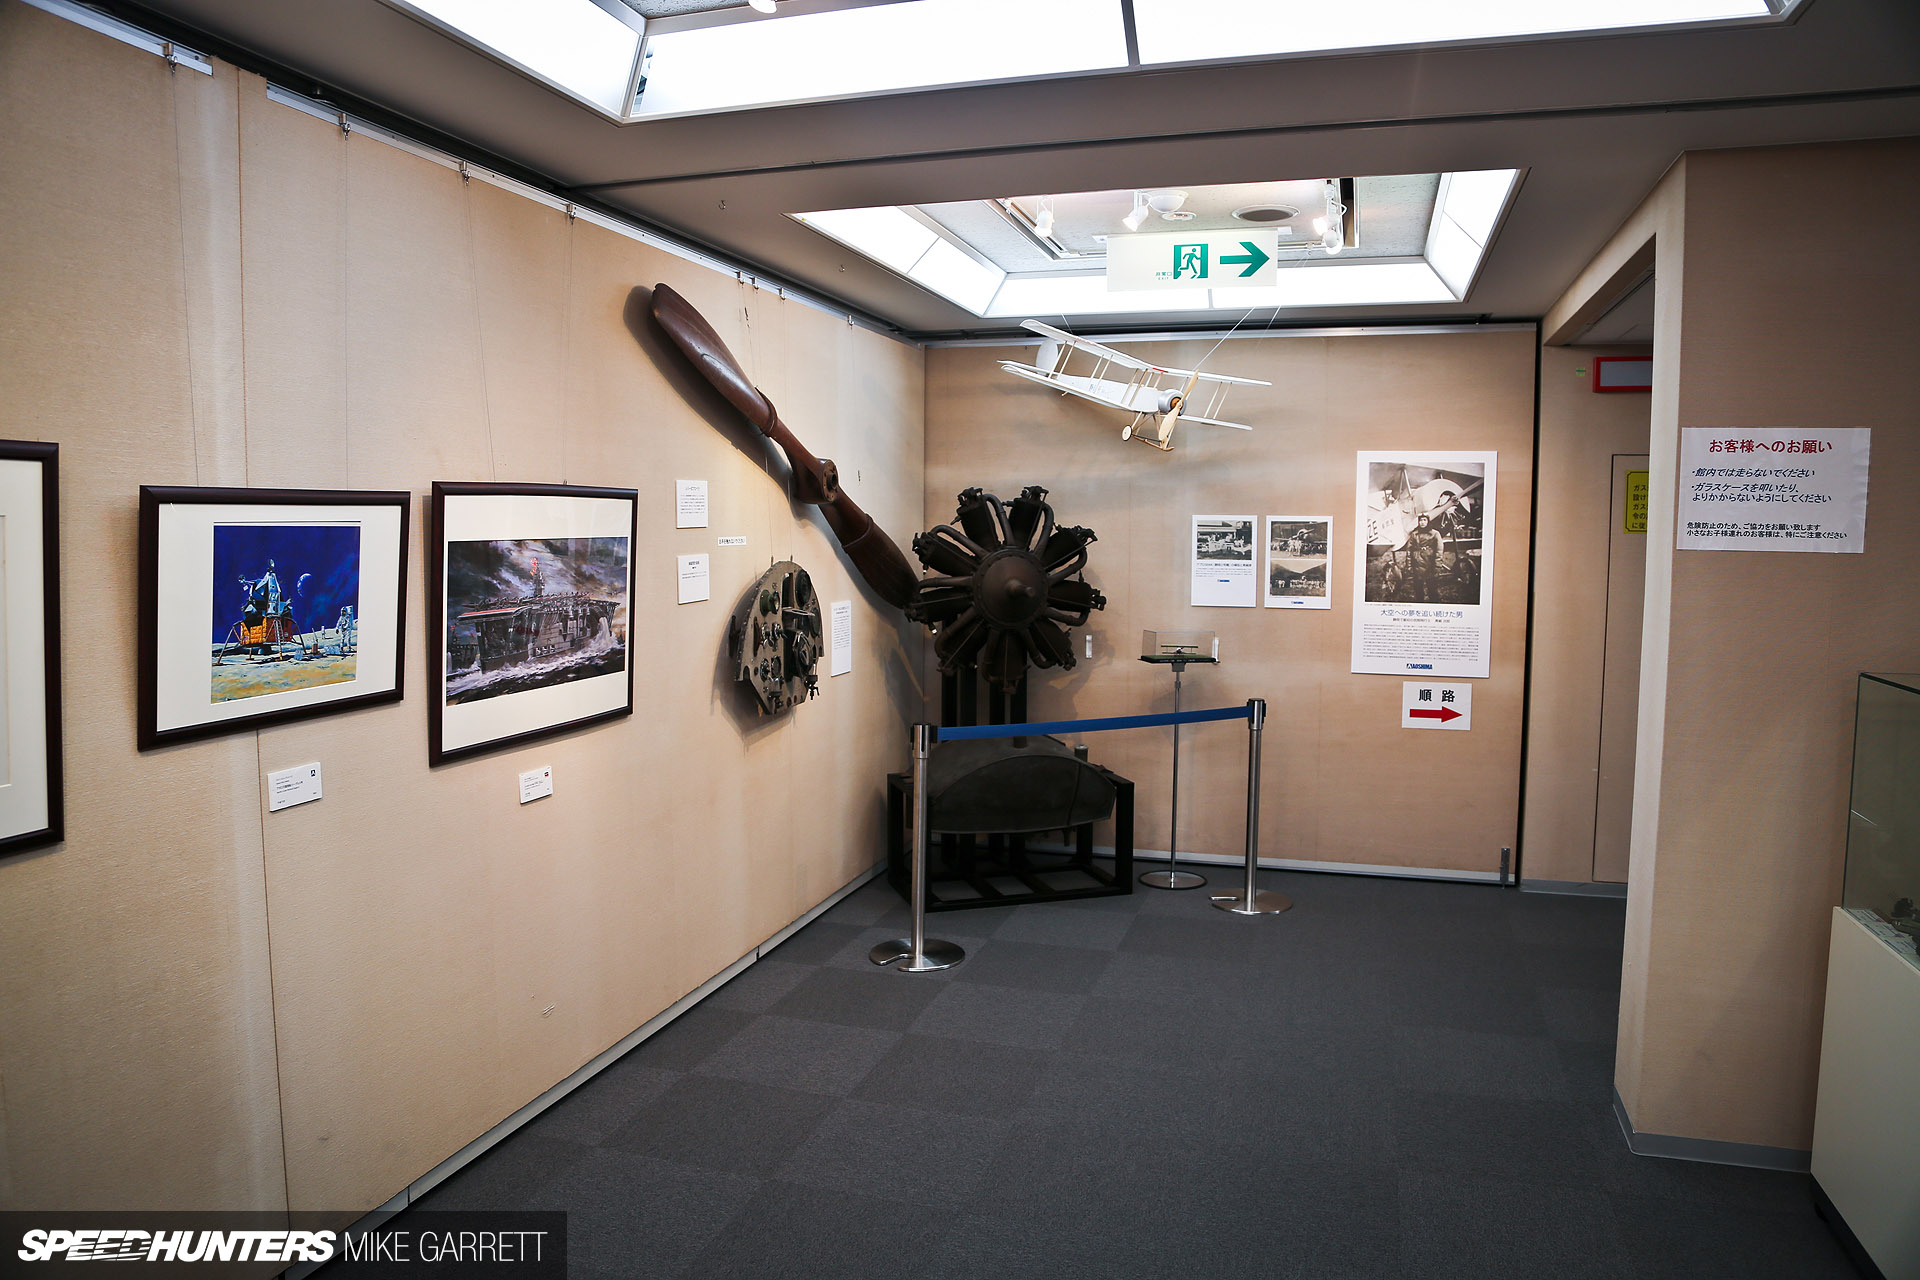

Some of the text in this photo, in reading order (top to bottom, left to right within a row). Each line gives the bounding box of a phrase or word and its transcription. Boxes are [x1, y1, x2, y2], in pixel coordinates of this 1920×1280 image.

[1709, 439, 1832, 454] お客様へのお願い
[1692, 492, 1832, 503] よりかからないようにしてください
[1380, 609, 1464, 619] 大空への夢を追い続けた男
